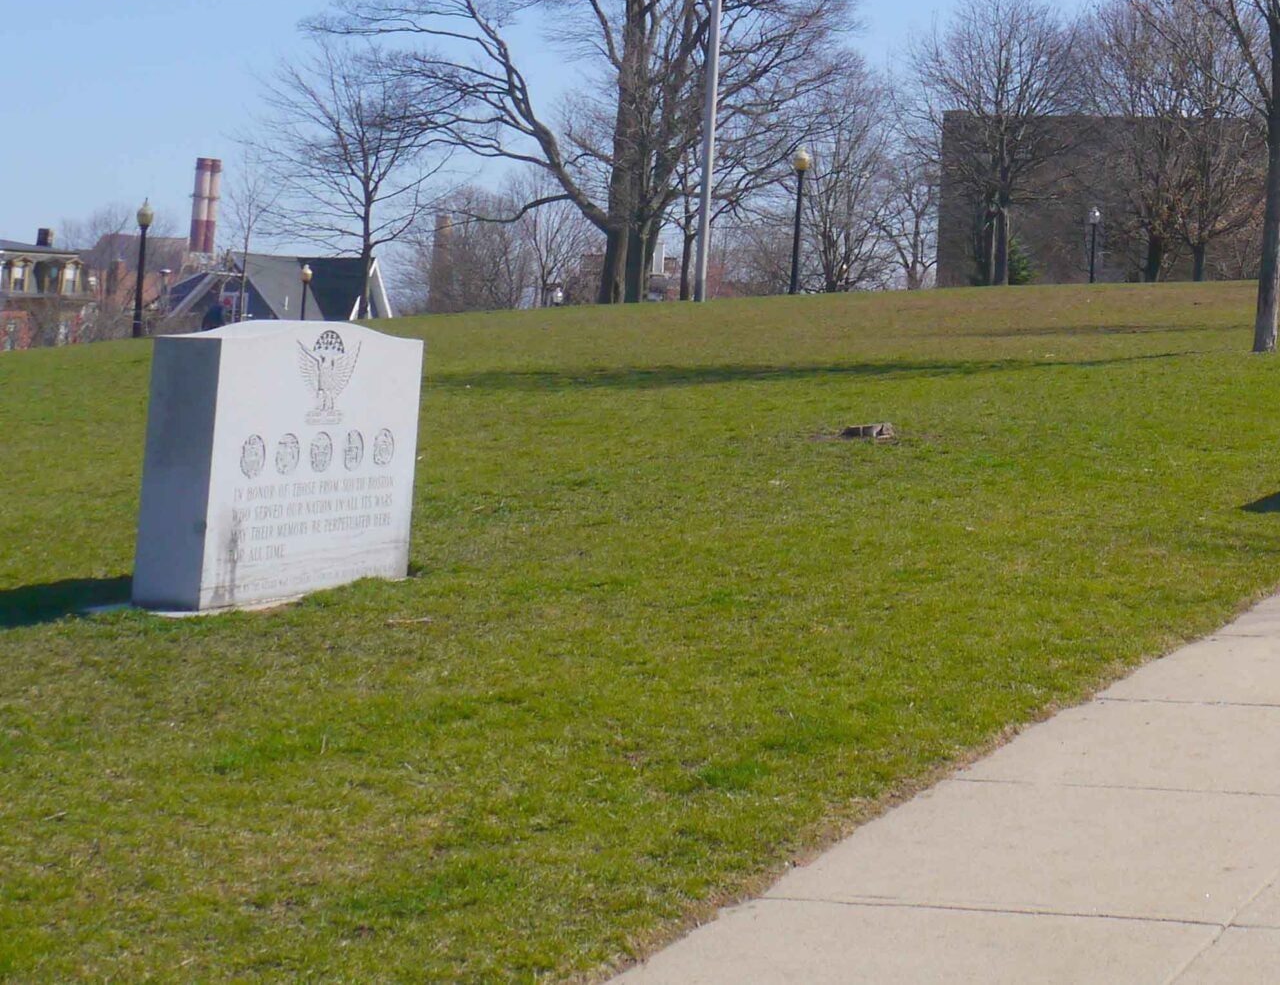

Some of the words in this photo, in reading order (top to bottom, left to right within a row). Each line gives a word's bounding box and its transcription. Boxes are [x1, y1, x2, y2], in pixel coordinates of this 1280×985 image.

[233, 486, 243, 502] IN
[247, 485, 275, 501] HONOR
[278, 483, 288, 498] OF
[293, 481, 316, 498] THOSE
[319, 479, 339, 494] FROM
[255, 504, 283, 520] SERVED
[286, 501, 303, 517] OUR
[306, 499, 332, 514] NATION
[336, 498, 344, 511] IN
[347, 496, 358, 510] ALL
[361, 494, 372, 509] ITS
[374, 493, 393, 507] WARS
[251, 525, 274, 541] THEIR
[277, 521, 308, 538] MEMORY
[312, 518, 321, 533] BE
[249, 546, 262, 562] ALL
[266, 543, 286, 560] TIME
